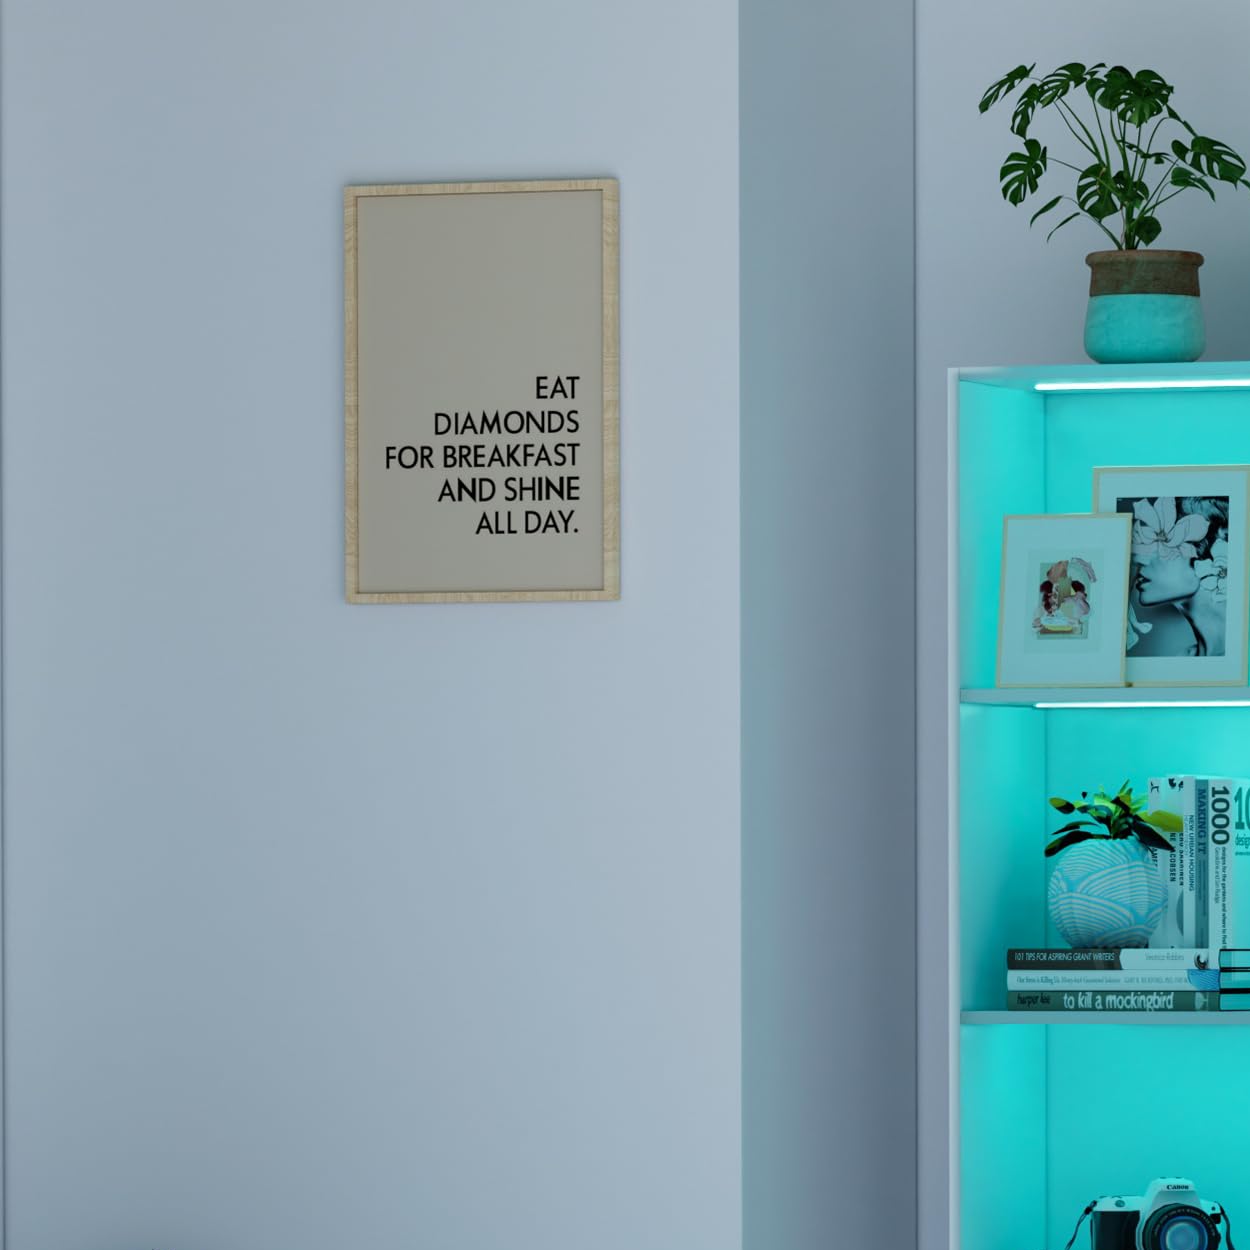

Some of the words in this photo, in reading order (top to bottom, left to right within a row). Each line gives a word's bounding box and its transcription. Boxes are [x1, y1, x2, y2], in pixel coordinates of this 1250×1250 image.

[536, 376, 580, 399] EAT
[434, 410, 580, 435] DIAMONDS
[386, 446, 434, 469] FOR
[443, 443, 580, 468] BREAKFAST
[437, 477, 496, 502] AND
[504, 476, 580, 501] SHINE
[475, 511, 517, 534] ALL
[525, 510, 578, 534] DAY.
[1211, 786, 1230, 845] 1000
[1048, 953, 1072, 961] ASPIRING
[1074, 953, 1091, 961] GRANT
[1093, 953, 1114, 961] WRITERS
[1064, 994, 1074, 1008] to
[1078, 993, 1091, 1008] kill
[1095, 997, 1100, 1008] a
[1106, 992, 1173, 1011] mockingbird
